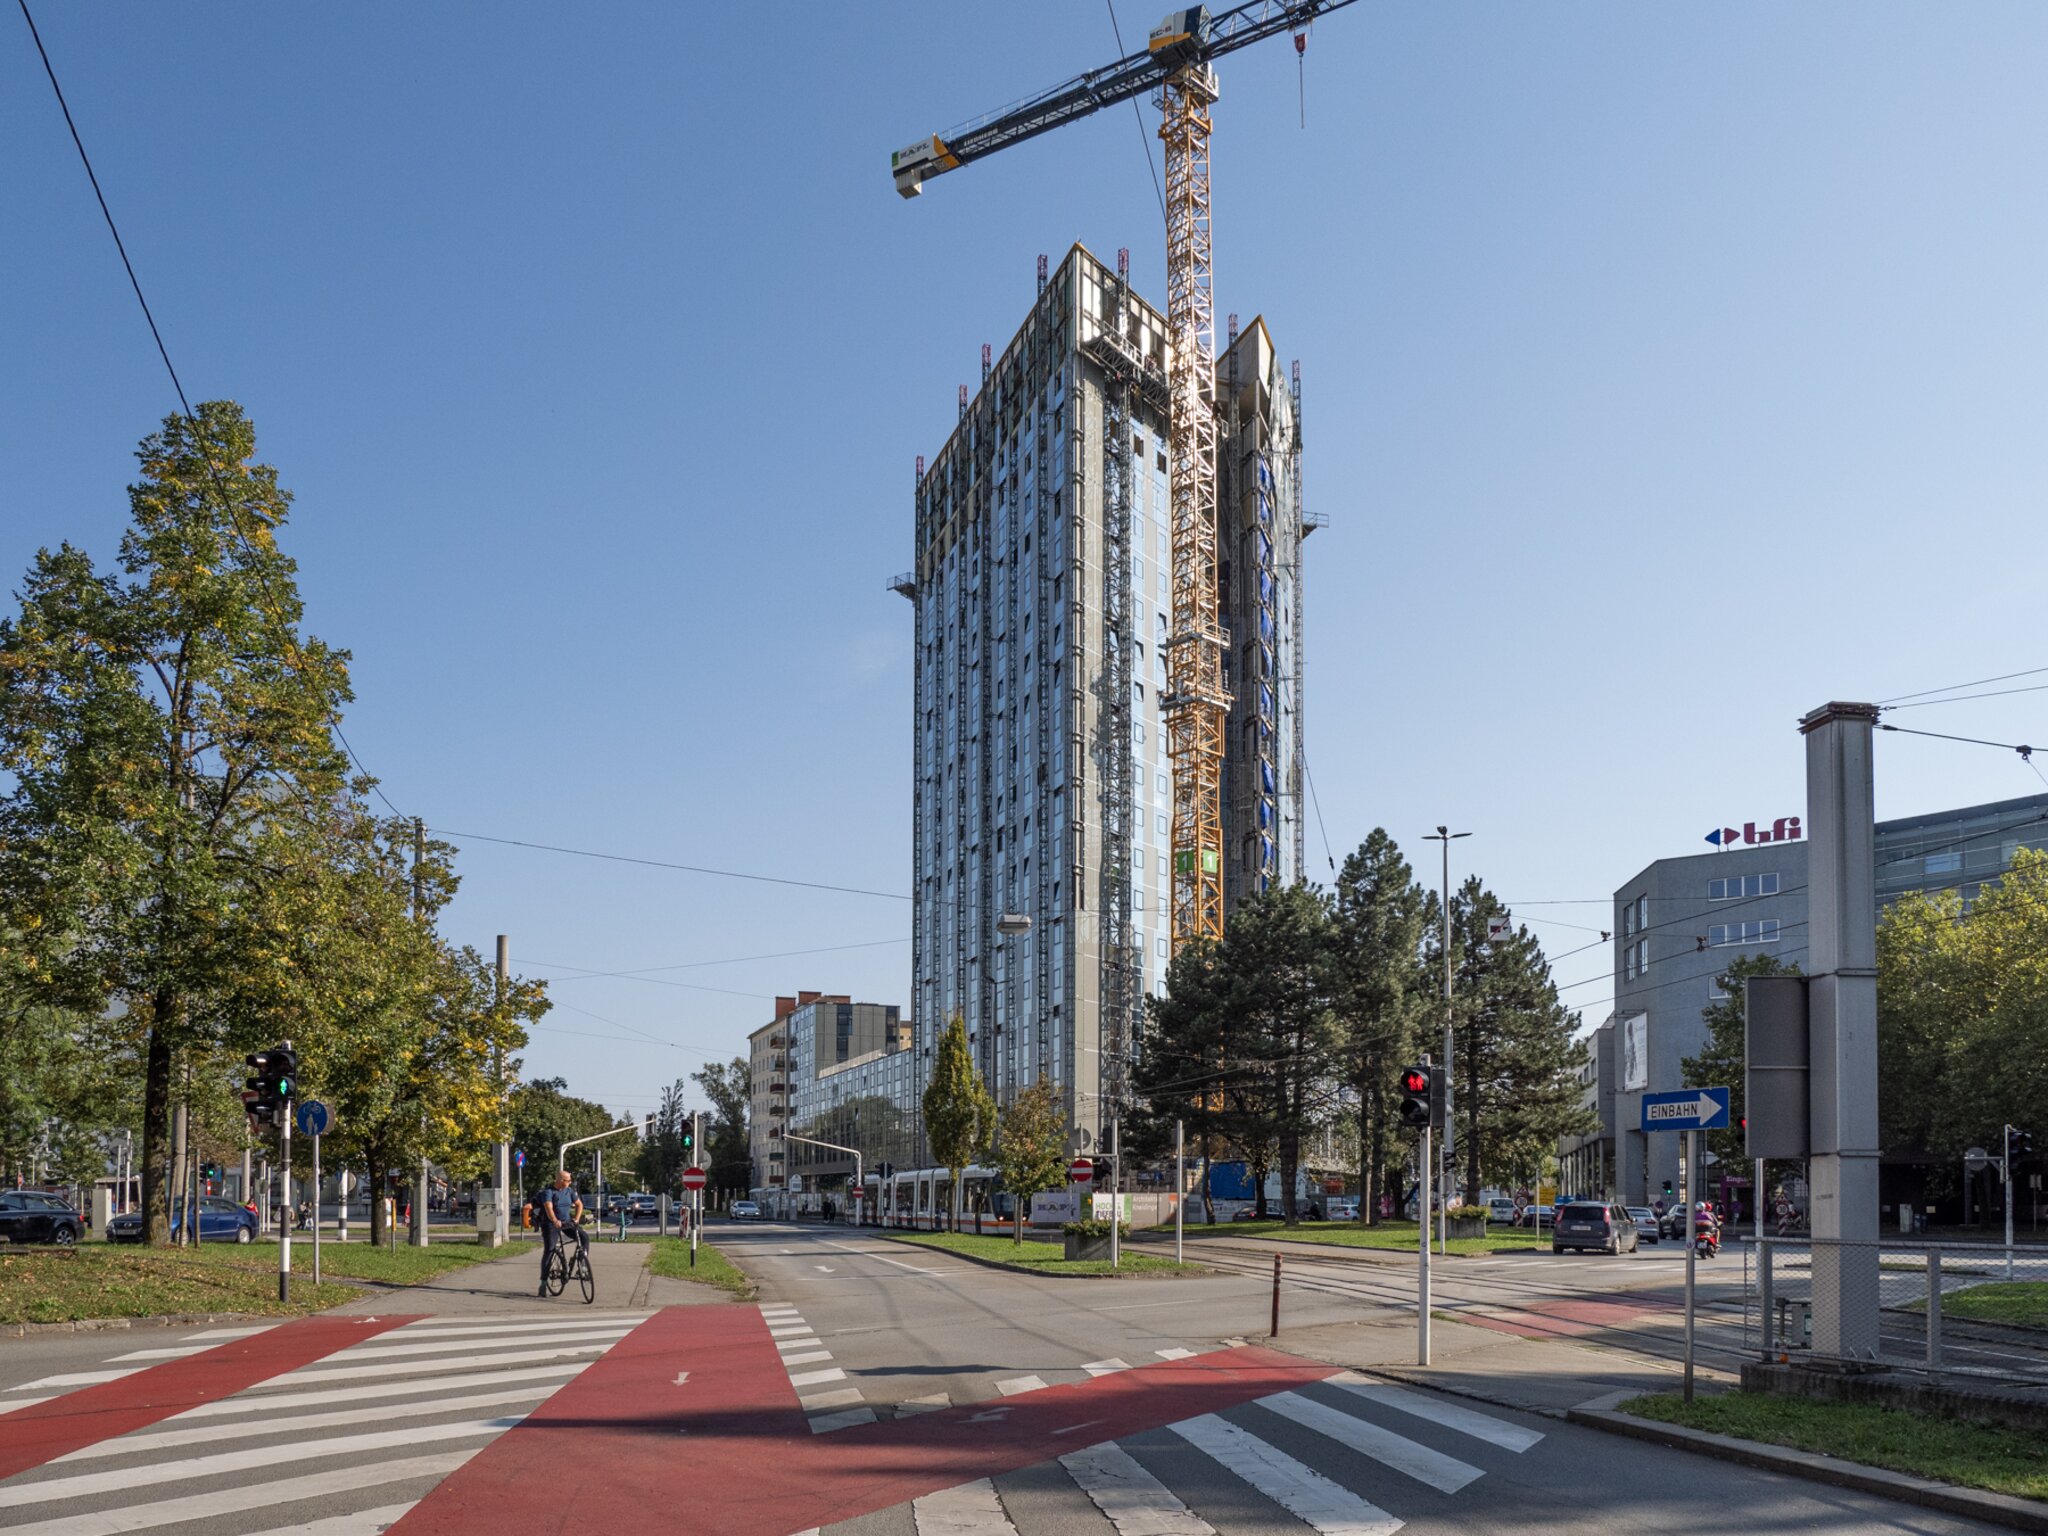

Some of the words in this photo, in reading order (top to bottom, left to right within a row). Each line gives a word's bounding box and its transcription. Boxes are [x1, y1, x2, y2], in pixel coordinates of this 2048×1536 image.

[1743, 816, 1802, 845] bfi
[1182, 854, 1188, 869] 1
[1207, 854, 1214, 869] 1
[1651, 1103, 1698, 1119] EINBAHN
